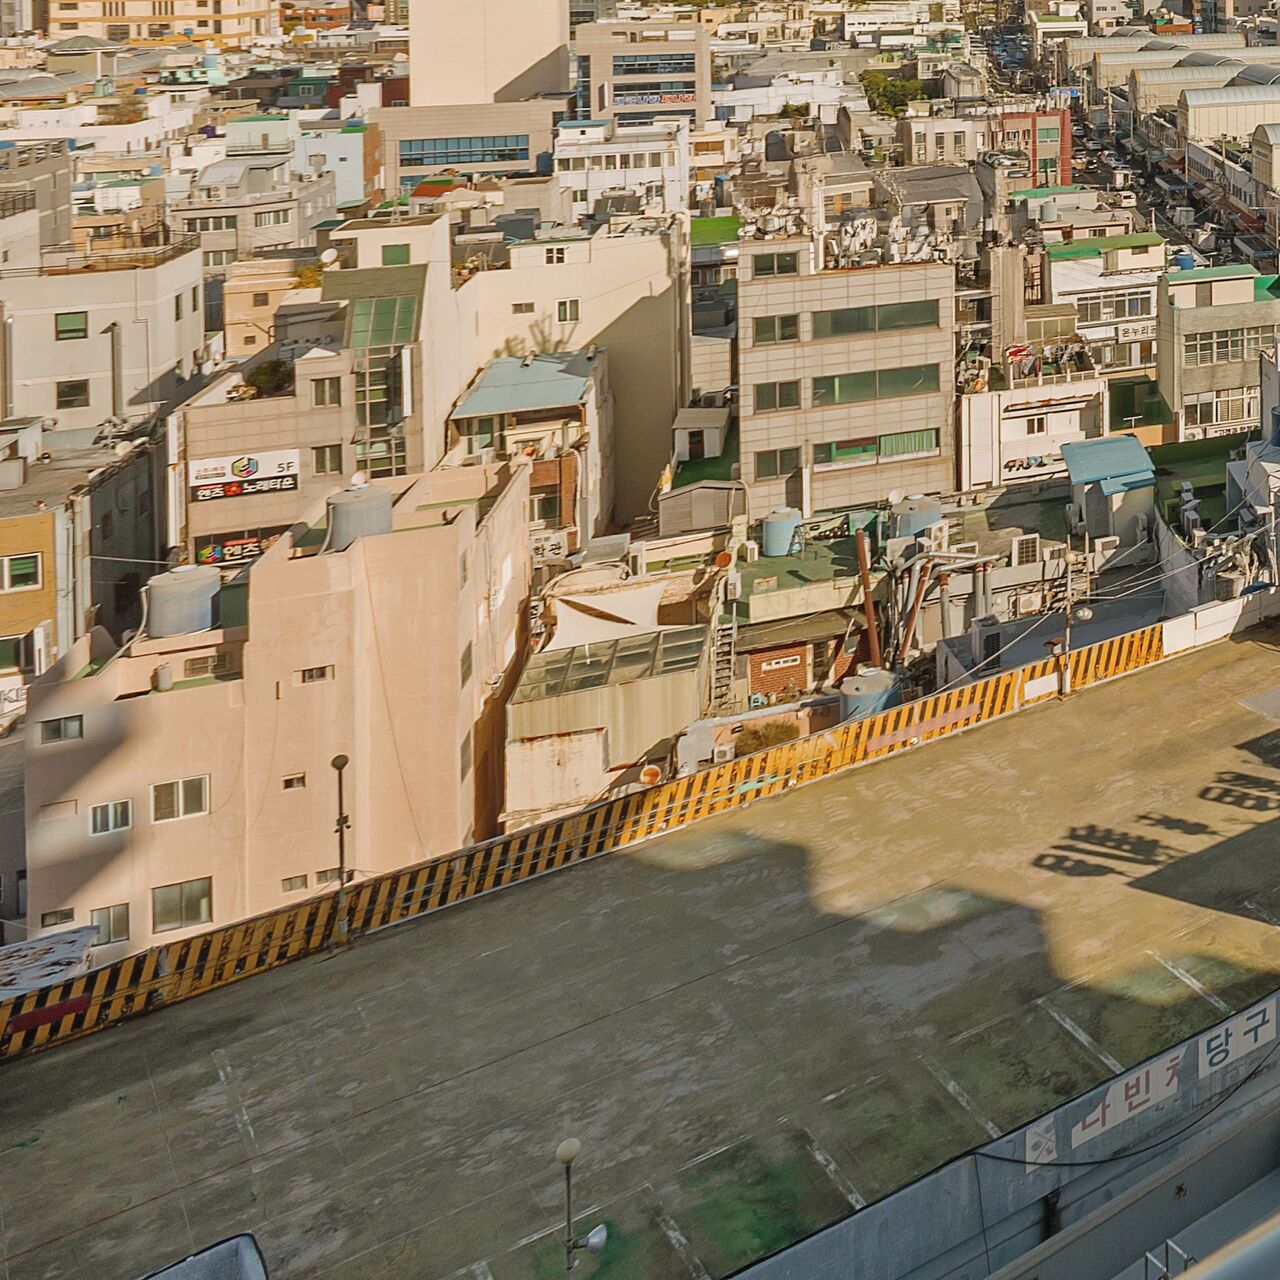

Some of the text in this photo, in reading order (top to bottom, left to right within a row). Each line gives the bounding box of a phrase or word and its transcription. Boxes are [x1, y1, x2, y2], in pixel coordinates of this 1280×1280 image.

[277, 461, 294, 473] 5F
[242, 477, 295, 494] 노래타운
[1206, 1007, 1271, 1068] 당구
